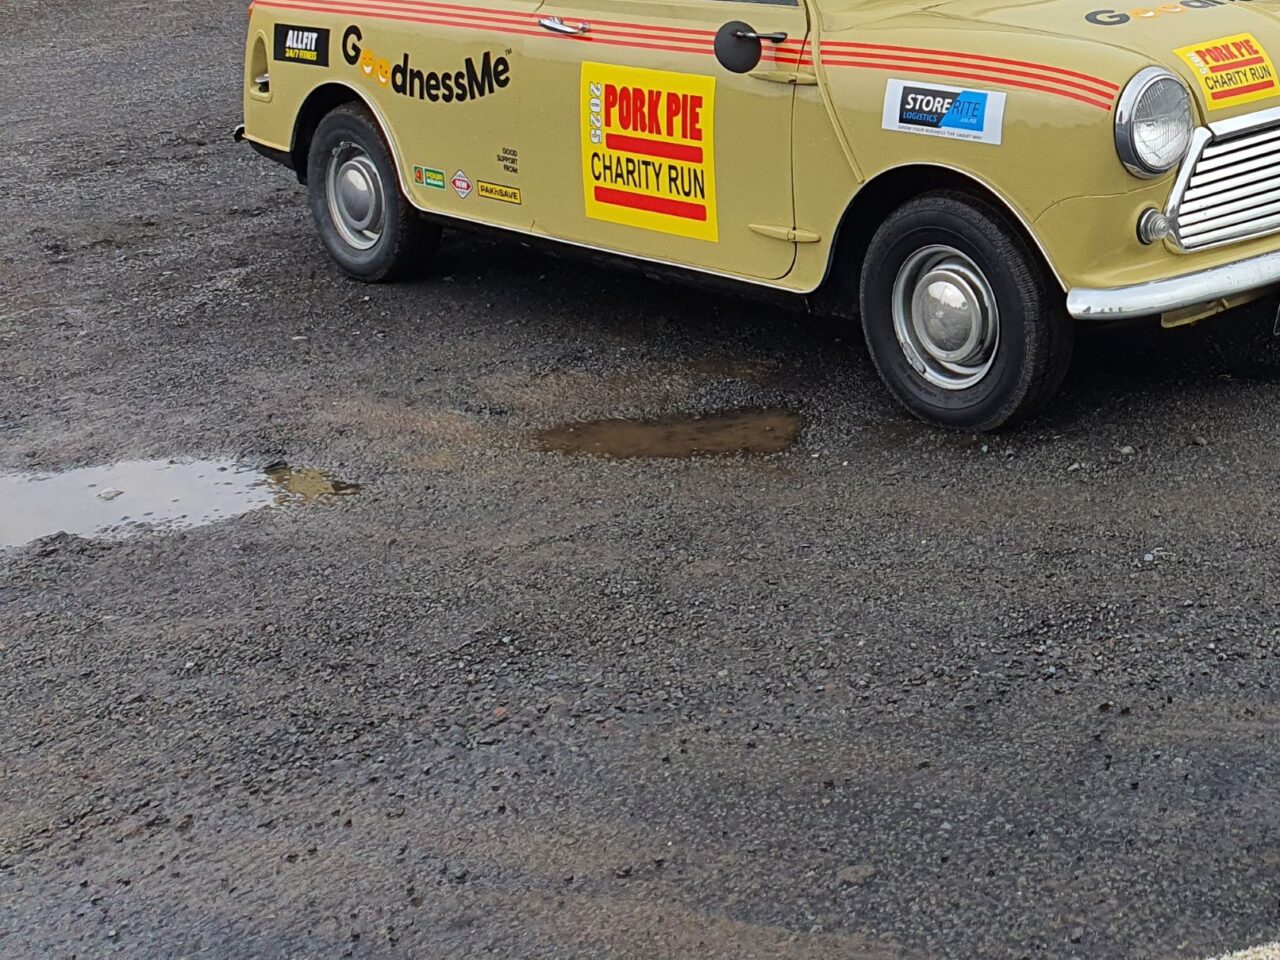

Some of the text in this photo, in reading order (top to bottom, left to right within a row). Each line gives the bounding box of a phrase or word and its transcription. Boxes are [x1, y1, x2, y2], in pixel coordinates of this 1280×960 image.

[286, 29, 319, 51] ALLFIT
[1194, 38, 1260, 65] PORK PIE
[1204, 65, 1272, 91] CHARITY RUN
[590, 81, 602, 144] 2025
[604, 83, 703, 141] PORK PIE
[903, 111, 938, 123] LOGISTICS
[591, 151, 705, 199] CHARITY RUN
